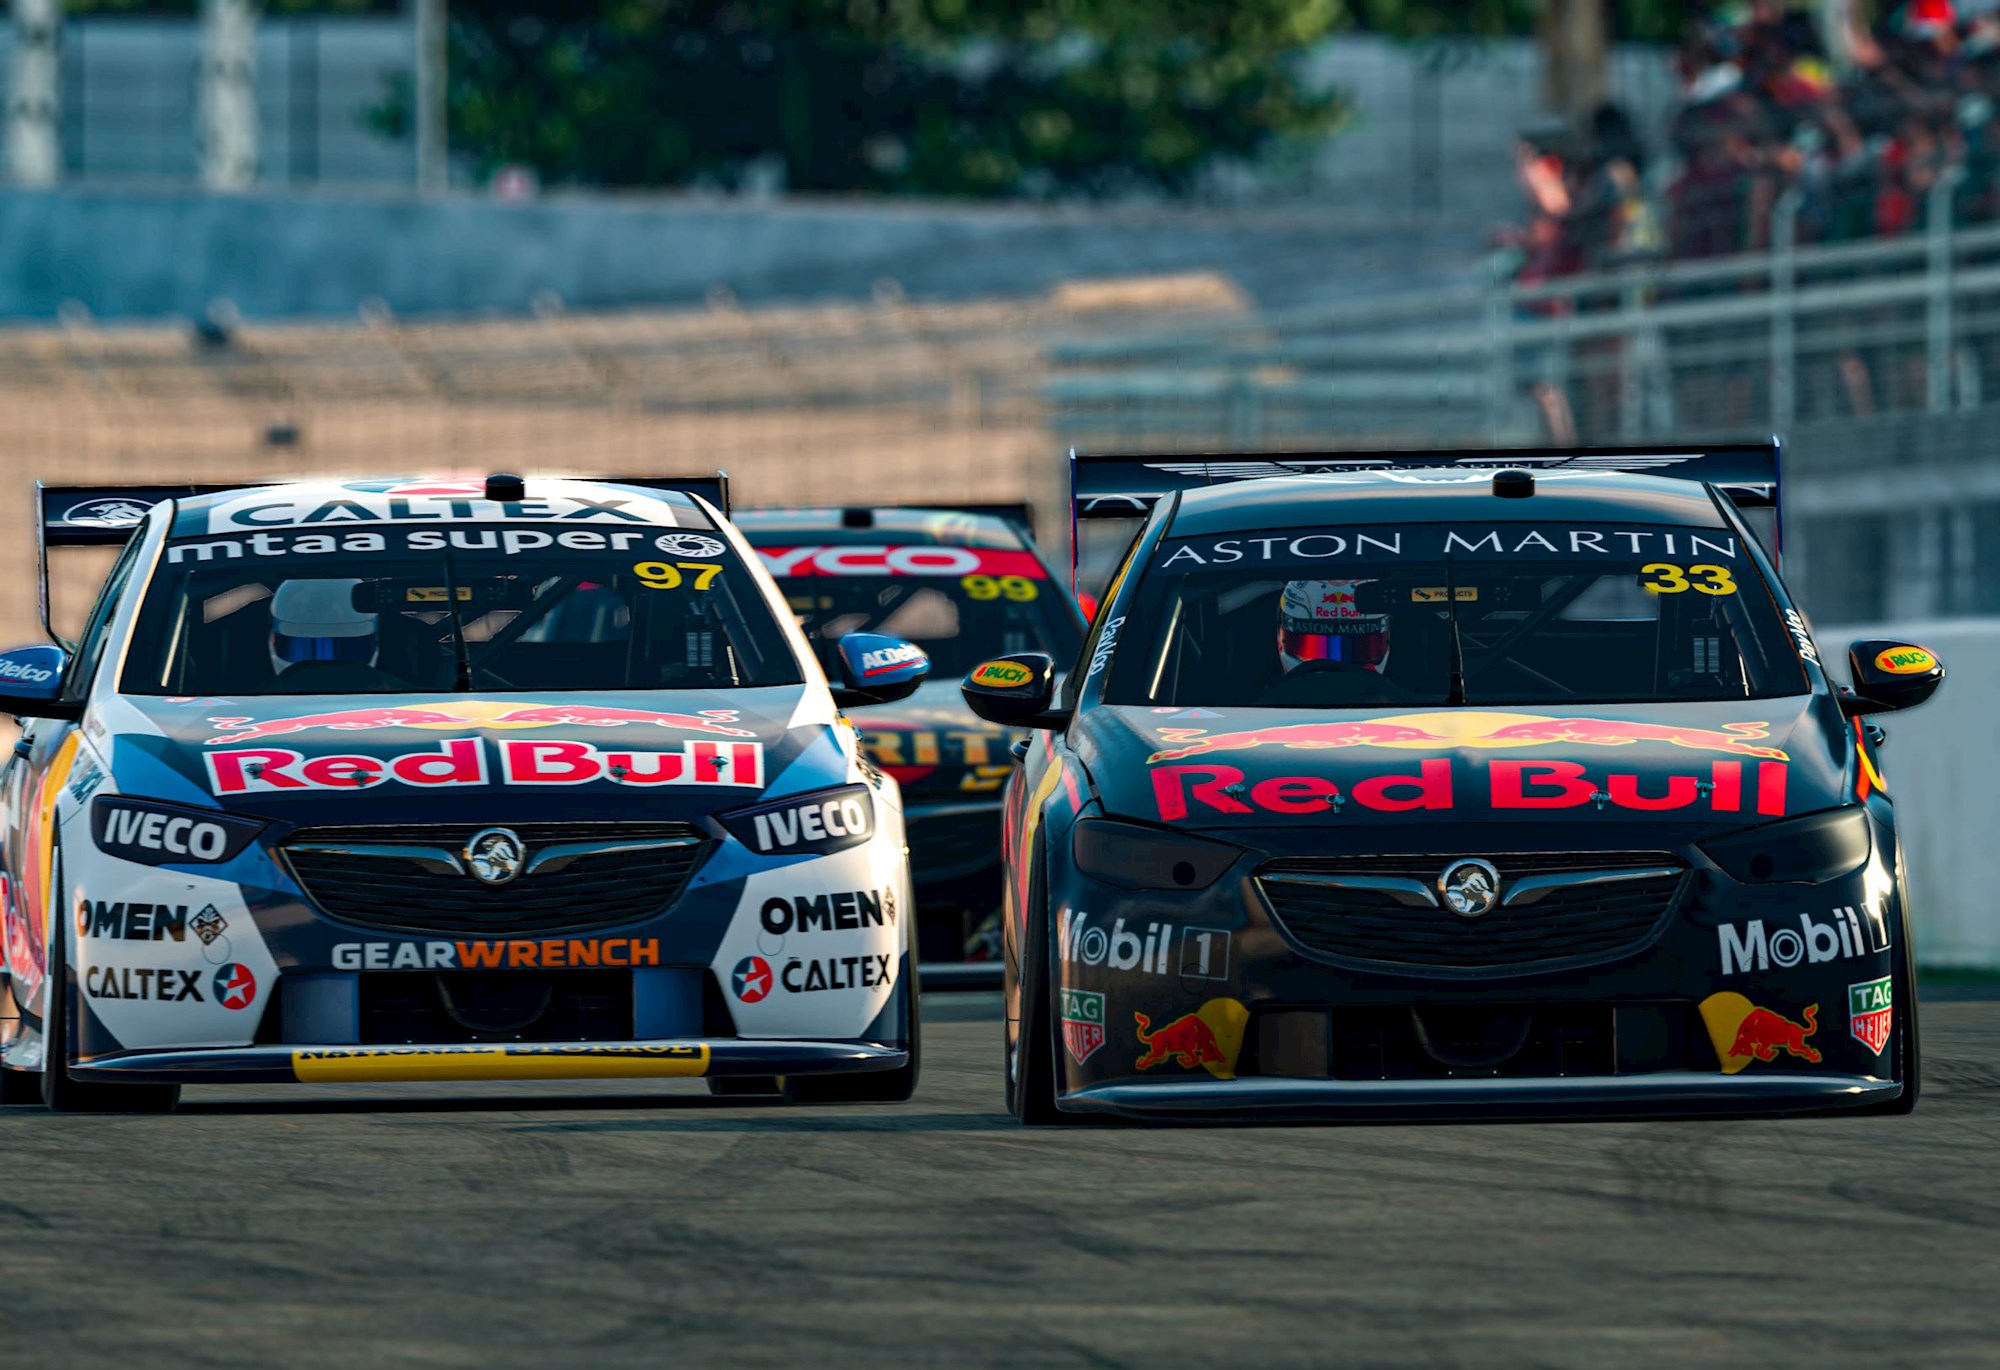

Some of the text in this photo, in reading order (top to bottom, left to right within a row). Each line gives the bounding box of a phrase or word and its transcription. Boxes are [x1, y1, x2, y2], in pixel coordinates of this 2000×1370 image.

[231, 496, 653, 527] CALTEX
[167, 529, 644, 564] mtaa super
[1162, 529, 1737, 568] ASTON MARTIN
[632, 561, 724, 591] 97
[959, 574, 1039, 602] 99
[1641, 562, 1738, 596] 33
[1434, 590, 1473, 598] PROUCTS
[1293, 621, 1381, 635] ASTON MARTIN
[1315, 606, 1338, 618] Red
[0, 658, 53, 682] Delco
[983, 665, 1028, 683] RAUCH
[862, 730, 1025, 766] RIT
[205, 738, 760, 794] Red Bull
[1150, 758, 1788, 822] Red Bull
[104, 807, 227, 861] IVECO
[753, 798, 867, 851] IVECO
[77, 898, 189, 942] OMEN
[760, 889, 884, 935] OMEN
[331, 938, 660, 970] GEARWRENCH
[1058, 907, 1212, 976] Mobil 1
[1717, 905, 1864, 975] Mobil
[86, 965, 205, 1002] CALTEX
[781, 953, 892, 993] CALTEX
[1061, 993, 1098, 1019] TAG
[1854, 982, 1892, 1010] TAG
